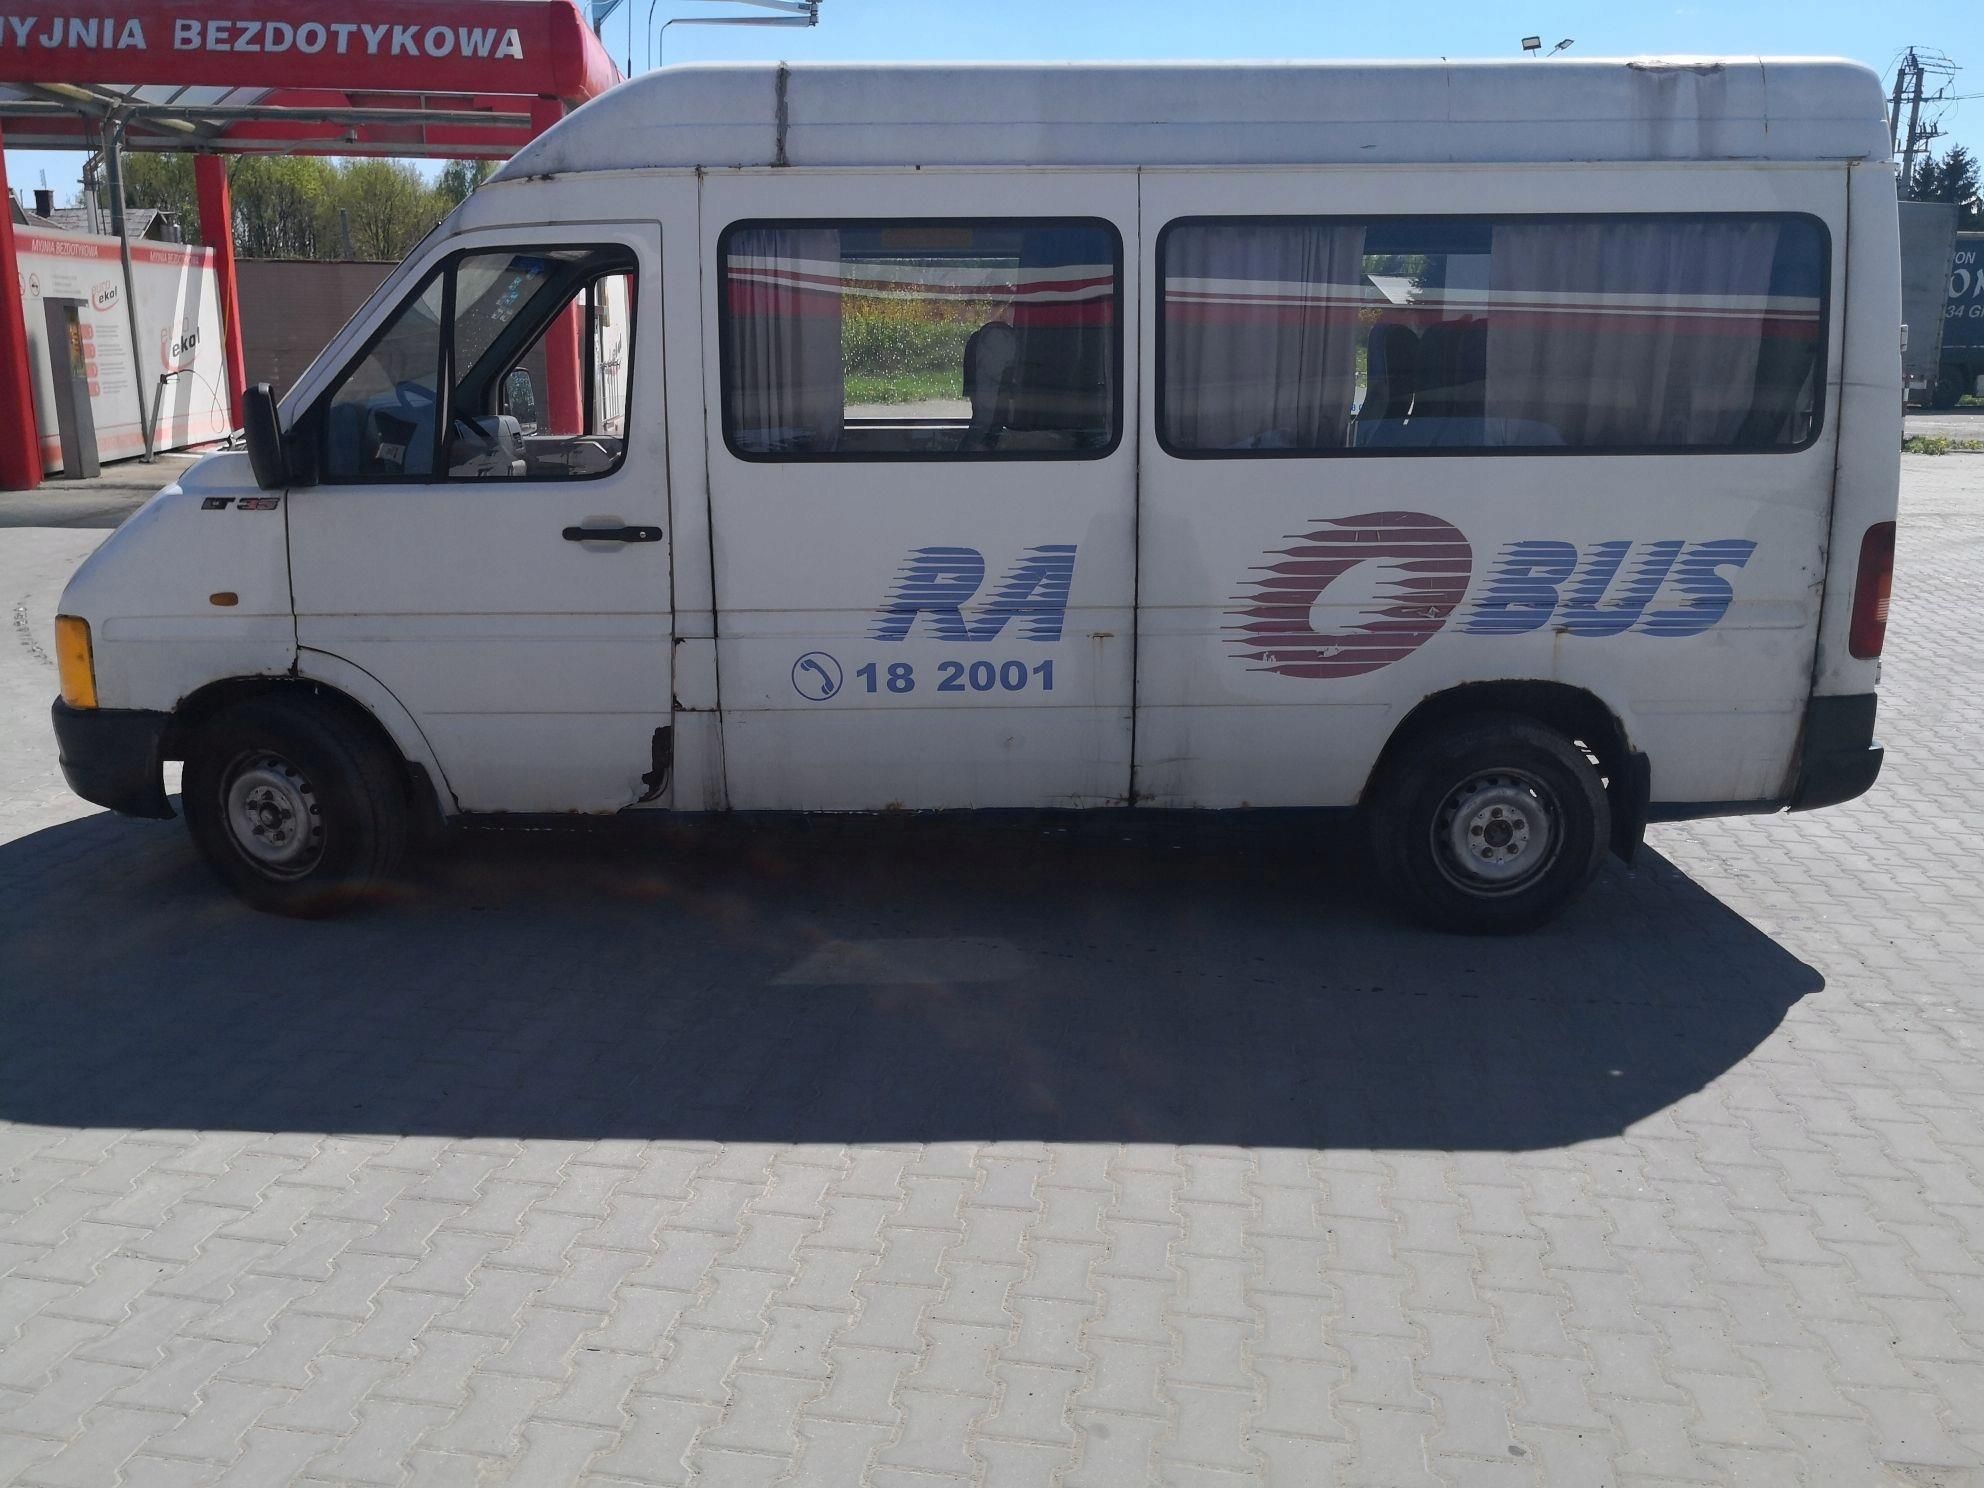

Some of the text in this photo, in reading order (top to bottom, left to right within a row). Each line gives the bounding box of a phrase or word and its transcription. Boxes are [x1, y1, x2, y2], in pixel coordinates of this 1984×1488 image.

[0, 16, 523, 59] YJNIA BEZDOTYKOWA
[864, 544, 1077, 641] RA
[1451, 539, 1758, 637] BUS
[856, 659, 1053, 693] 18 2001
